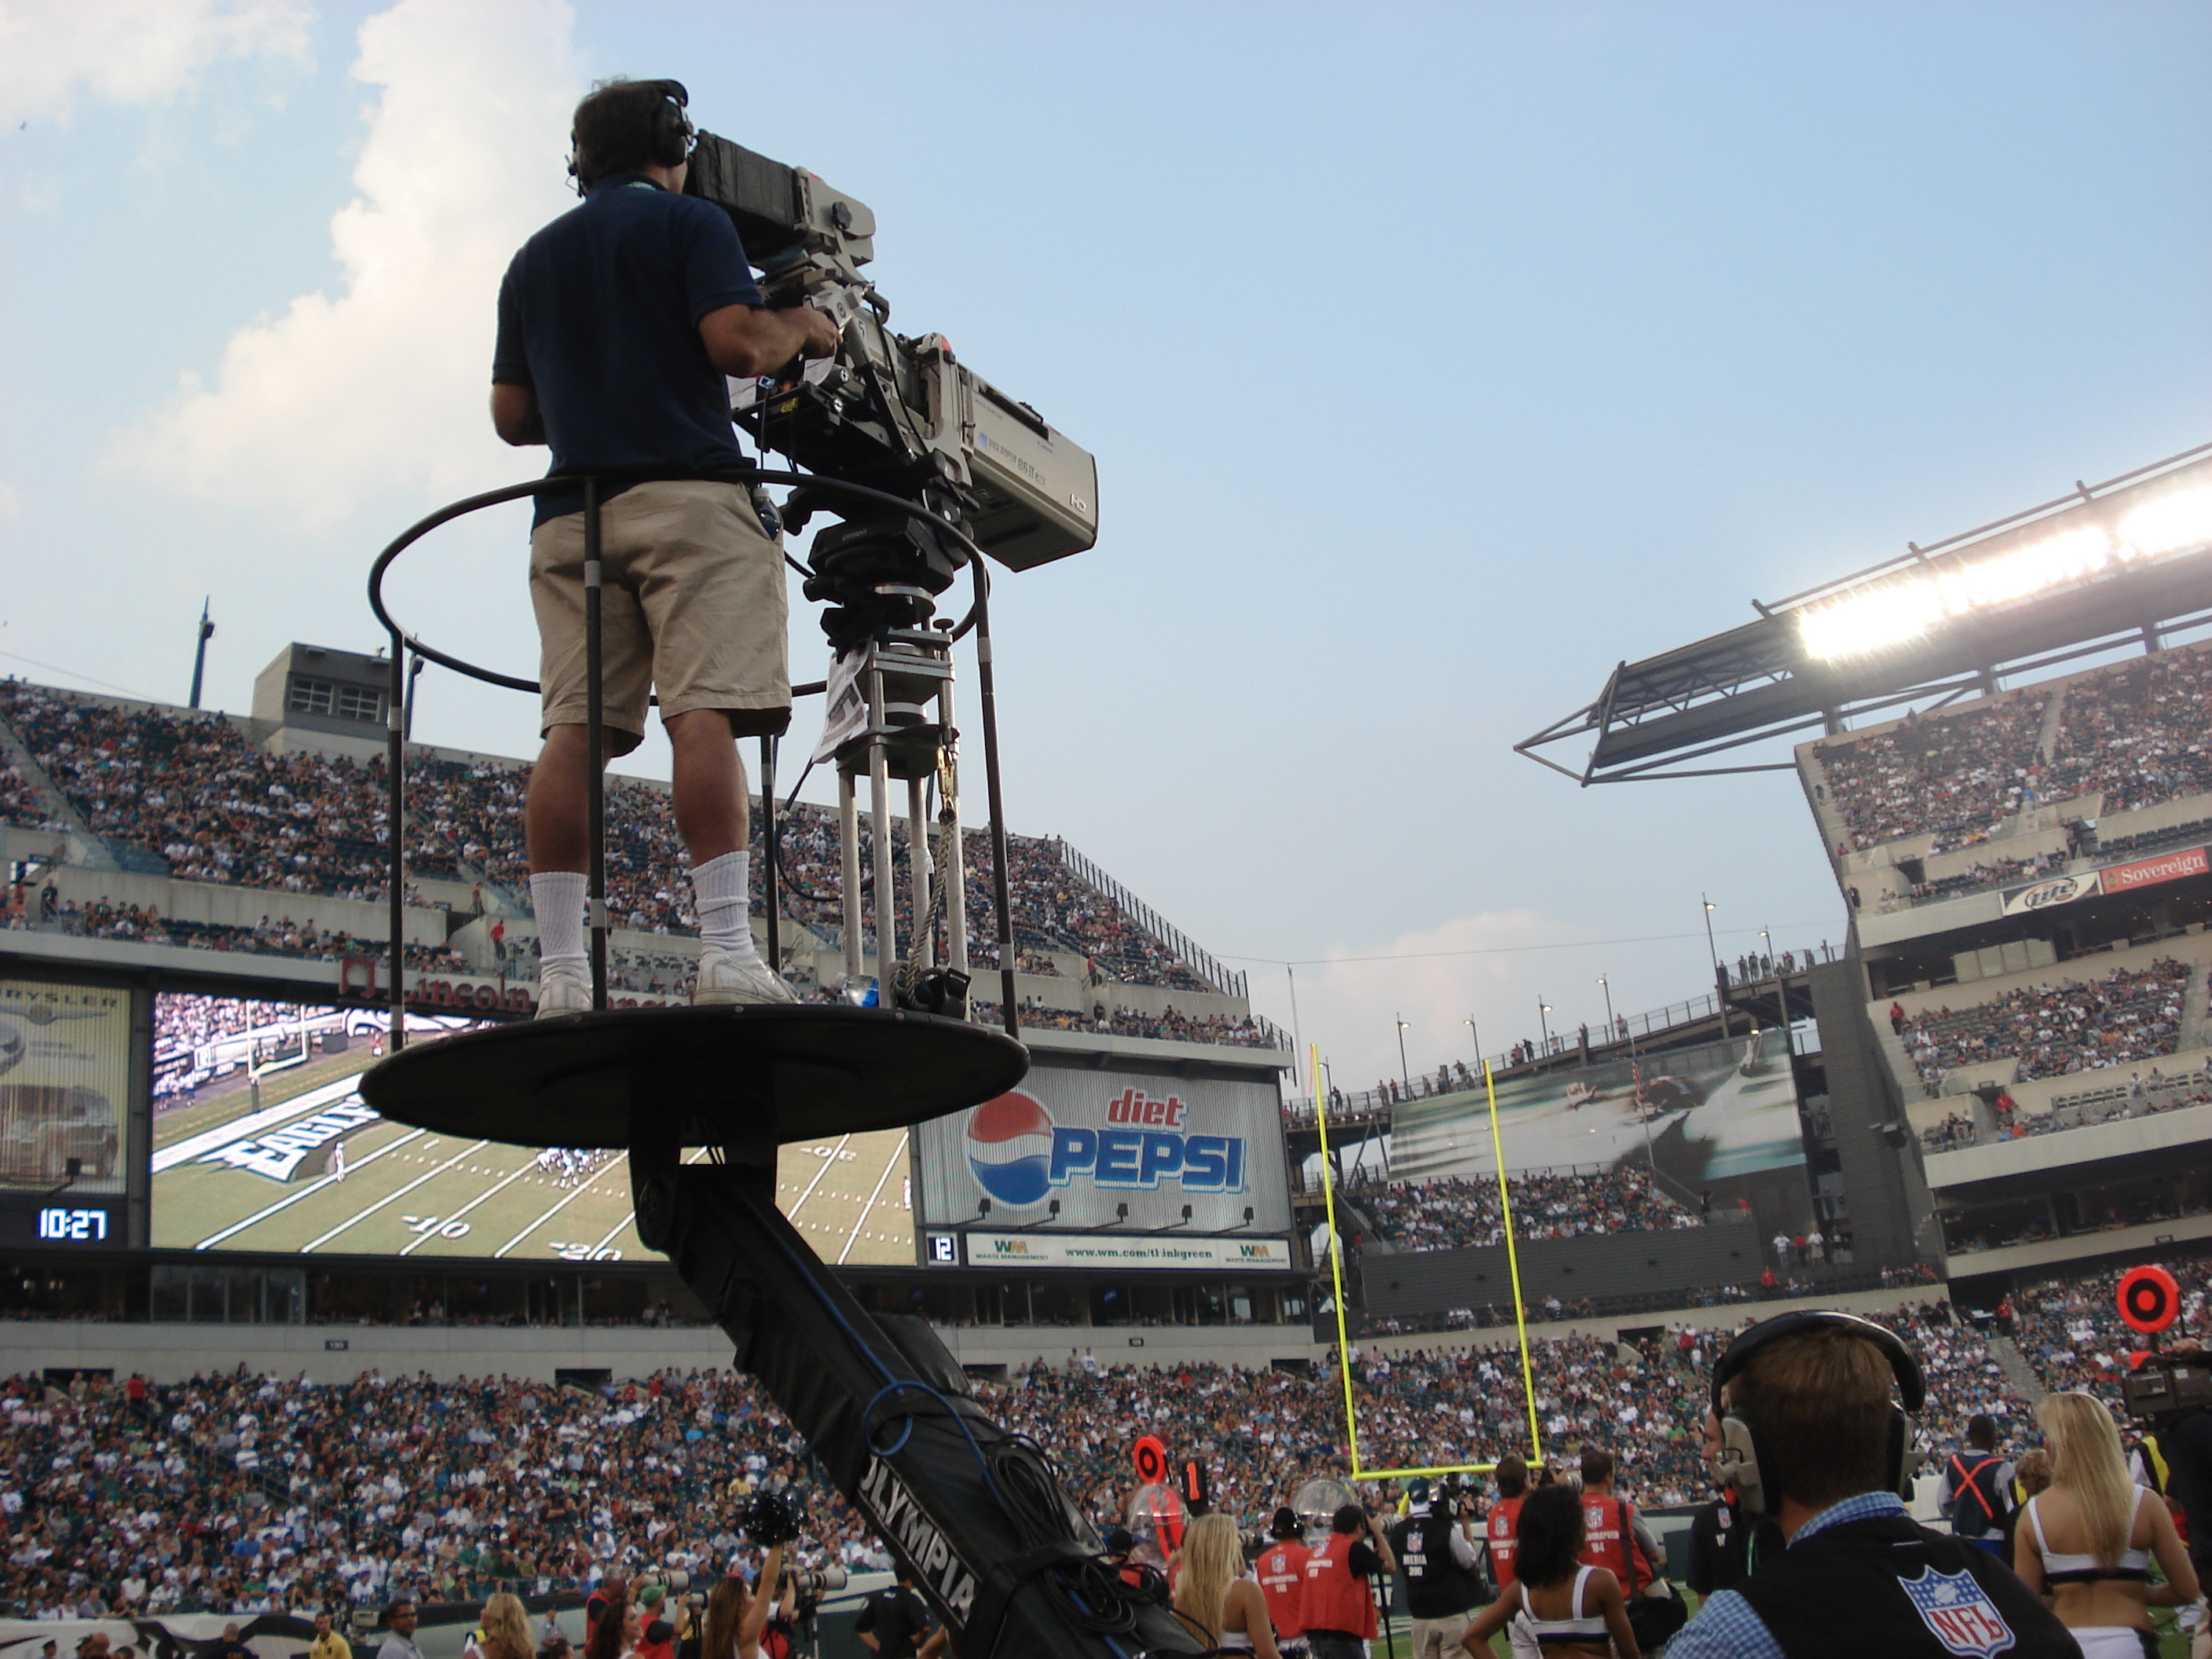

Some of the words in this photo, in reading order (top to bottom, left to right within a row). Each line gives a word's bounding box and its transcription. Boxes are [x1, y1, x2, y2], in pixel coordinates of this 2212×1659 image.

[2122, 855, 2205, 885] Sovereign
[0, 989, 117, 1008] RYSLER
[1107, 1088, 1185, 1128] diet
[1048, 1126, 1247, 1194] PEPSI
[40, 1208, 108, 1240] 10:27
[935, 1236, 953, 1262] 12
[994, 1240, 1029, 1254] WM
[1240, 1245, 1270, 1258] WM
[1187, 1462, 1200, 1501] 1
[1403, 1555, 1427, 1565] MEDIA
[1928, 1604, 2005, 1649] NFL
